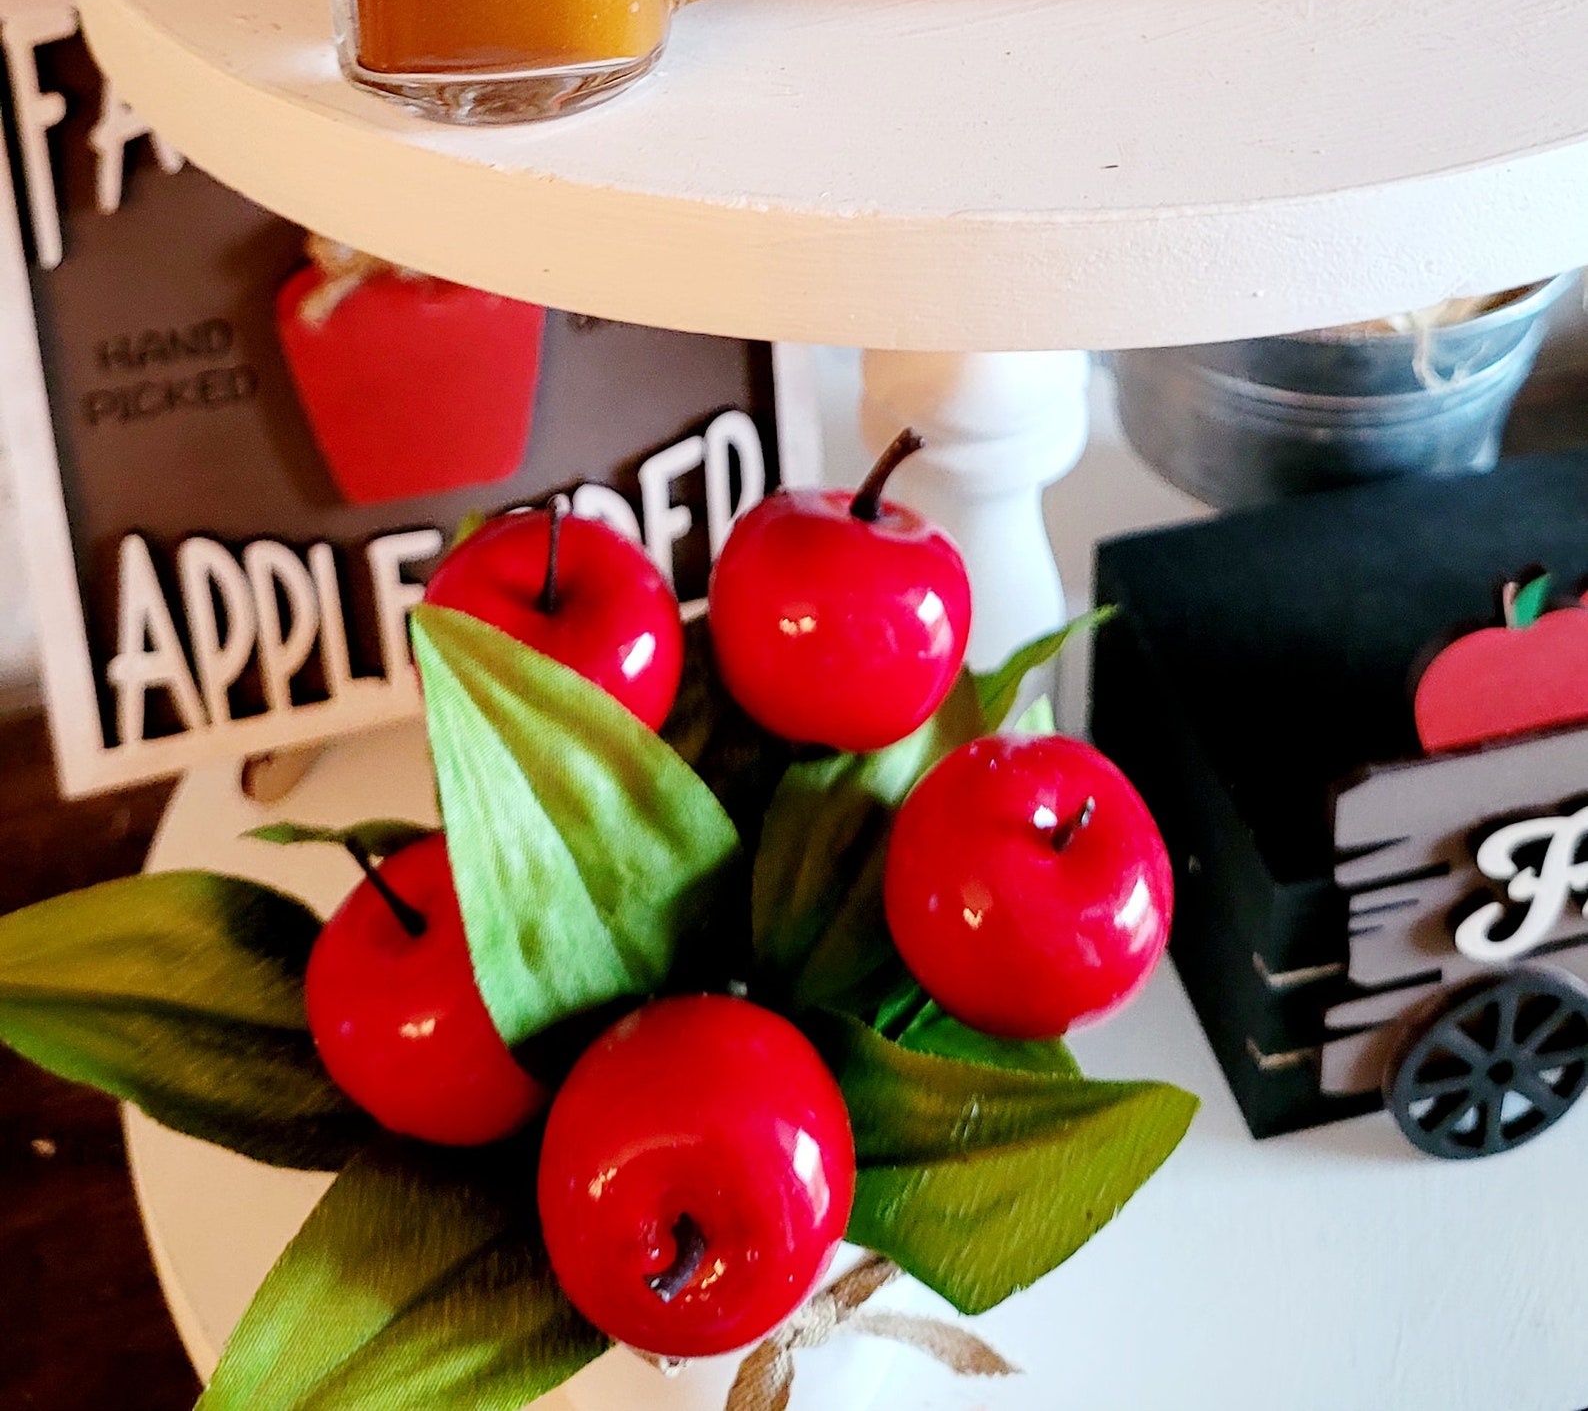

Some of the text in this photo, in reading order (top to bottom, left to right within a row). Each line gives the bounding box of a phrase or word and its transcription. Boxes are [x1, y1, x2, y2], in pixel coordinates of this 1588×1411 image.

[98, 317, 235, 371] HAND
[79, 363, 260, 427] PICKED
[107, 529, 443, 751] APPLE
